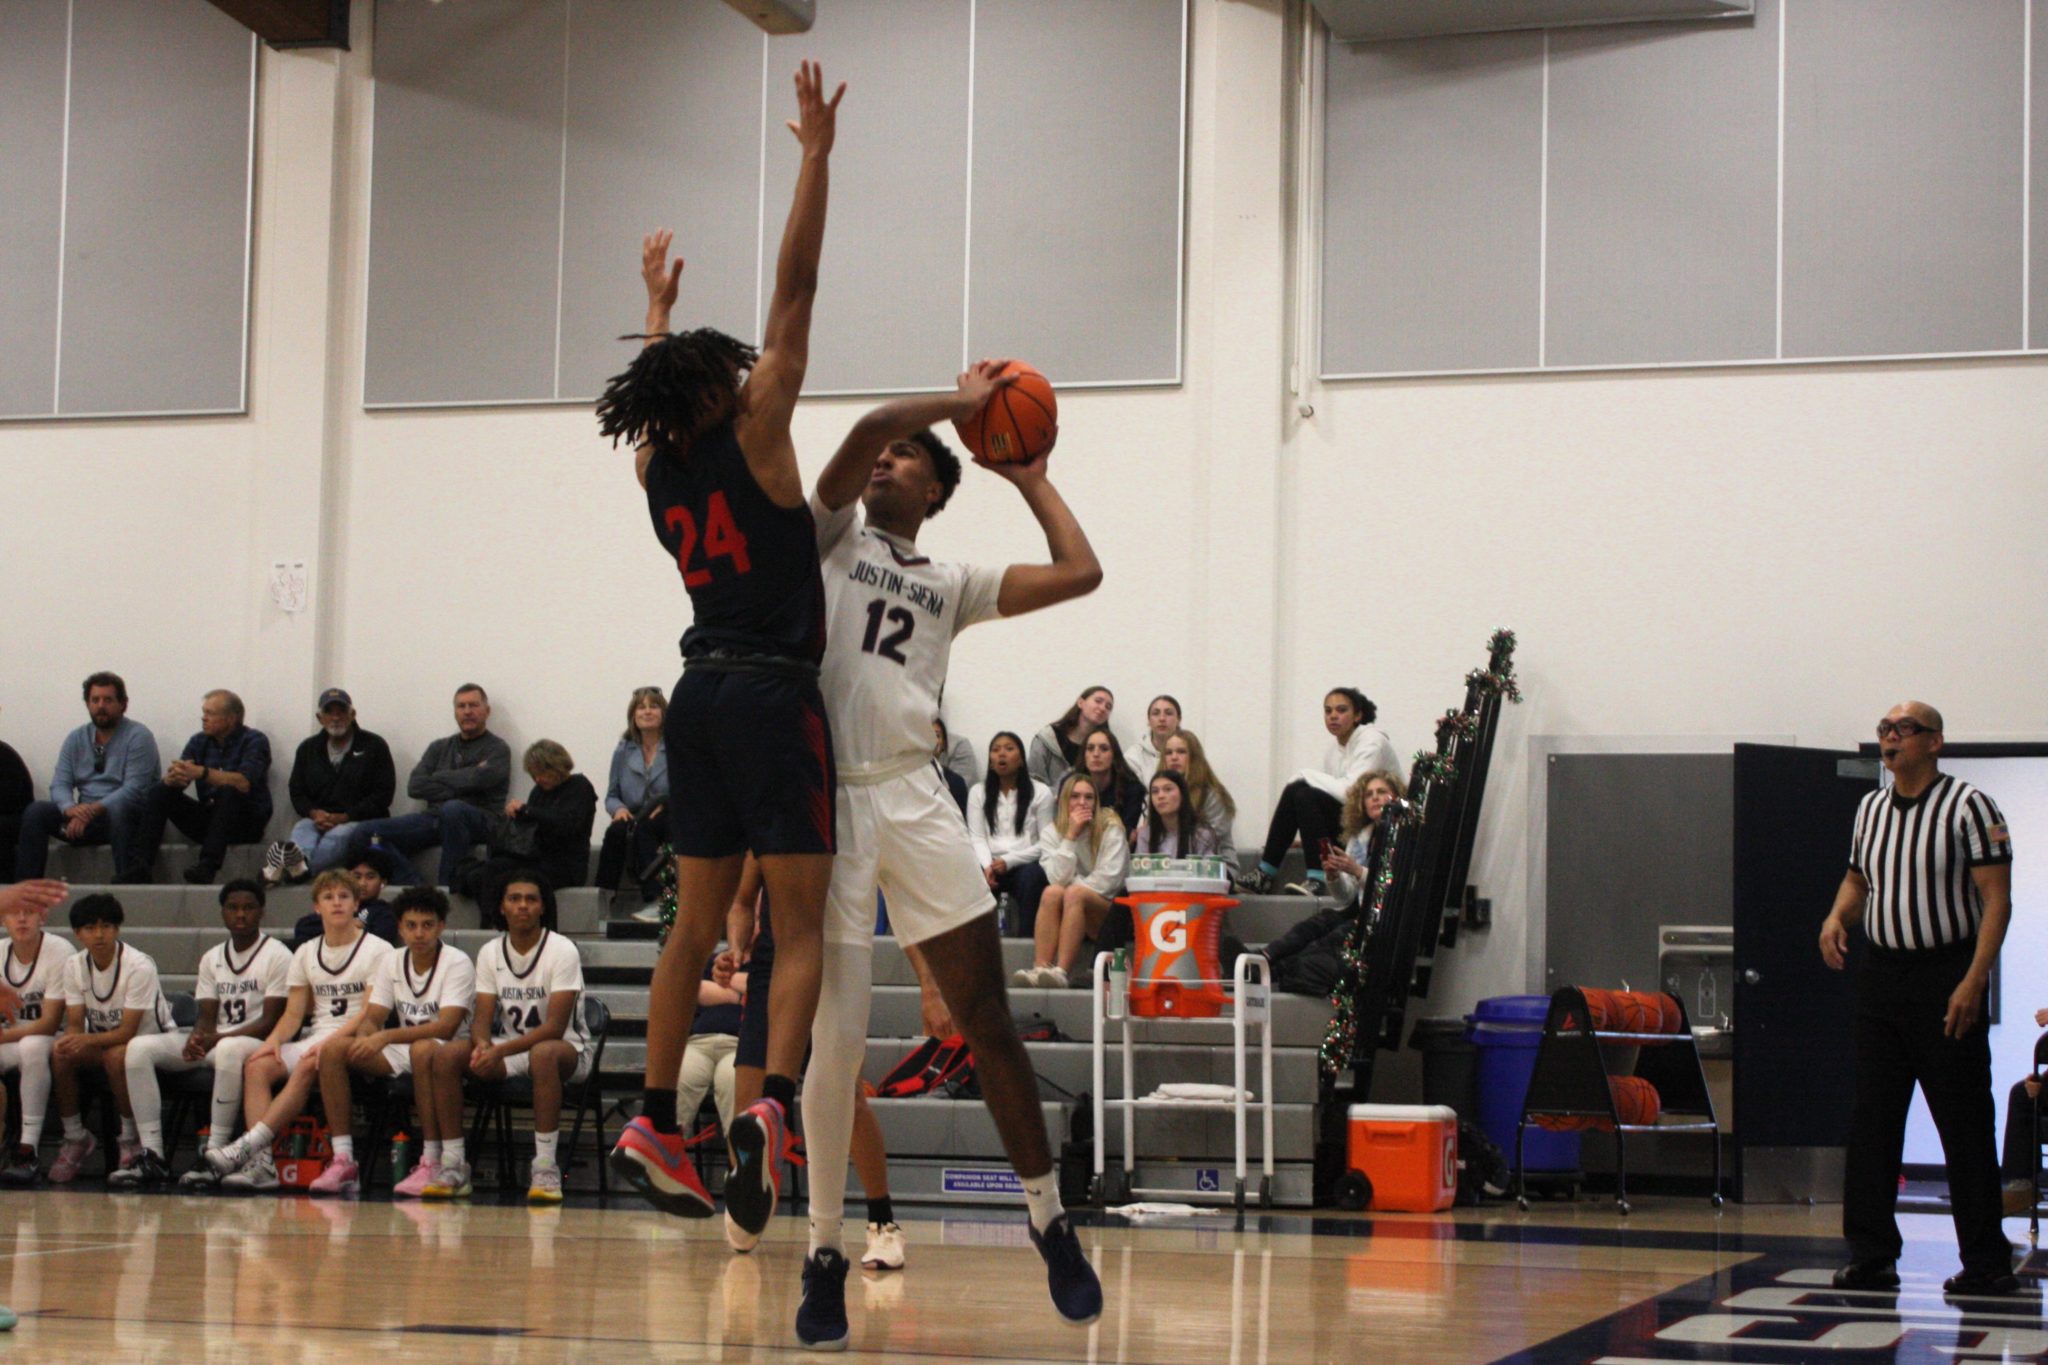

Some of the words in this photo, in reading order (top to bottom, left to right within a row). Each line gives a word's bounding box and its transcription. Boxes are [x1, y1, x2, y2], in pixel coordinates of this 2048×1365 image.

[664, 489, 751, 588] 24
[849, 560, 946, 619] JUSTIN-SIENA
[861, 599, 916, 667] 12
[1150, 910, 1186, 952] G
[223, 998, 246, 1025] 13
[330, 998, 348, 1017] 3
[507, 1005, 542, 1035] 24
[282, 1164, 298, 1183] G
[1444, 1137, 1455, 1188] G
